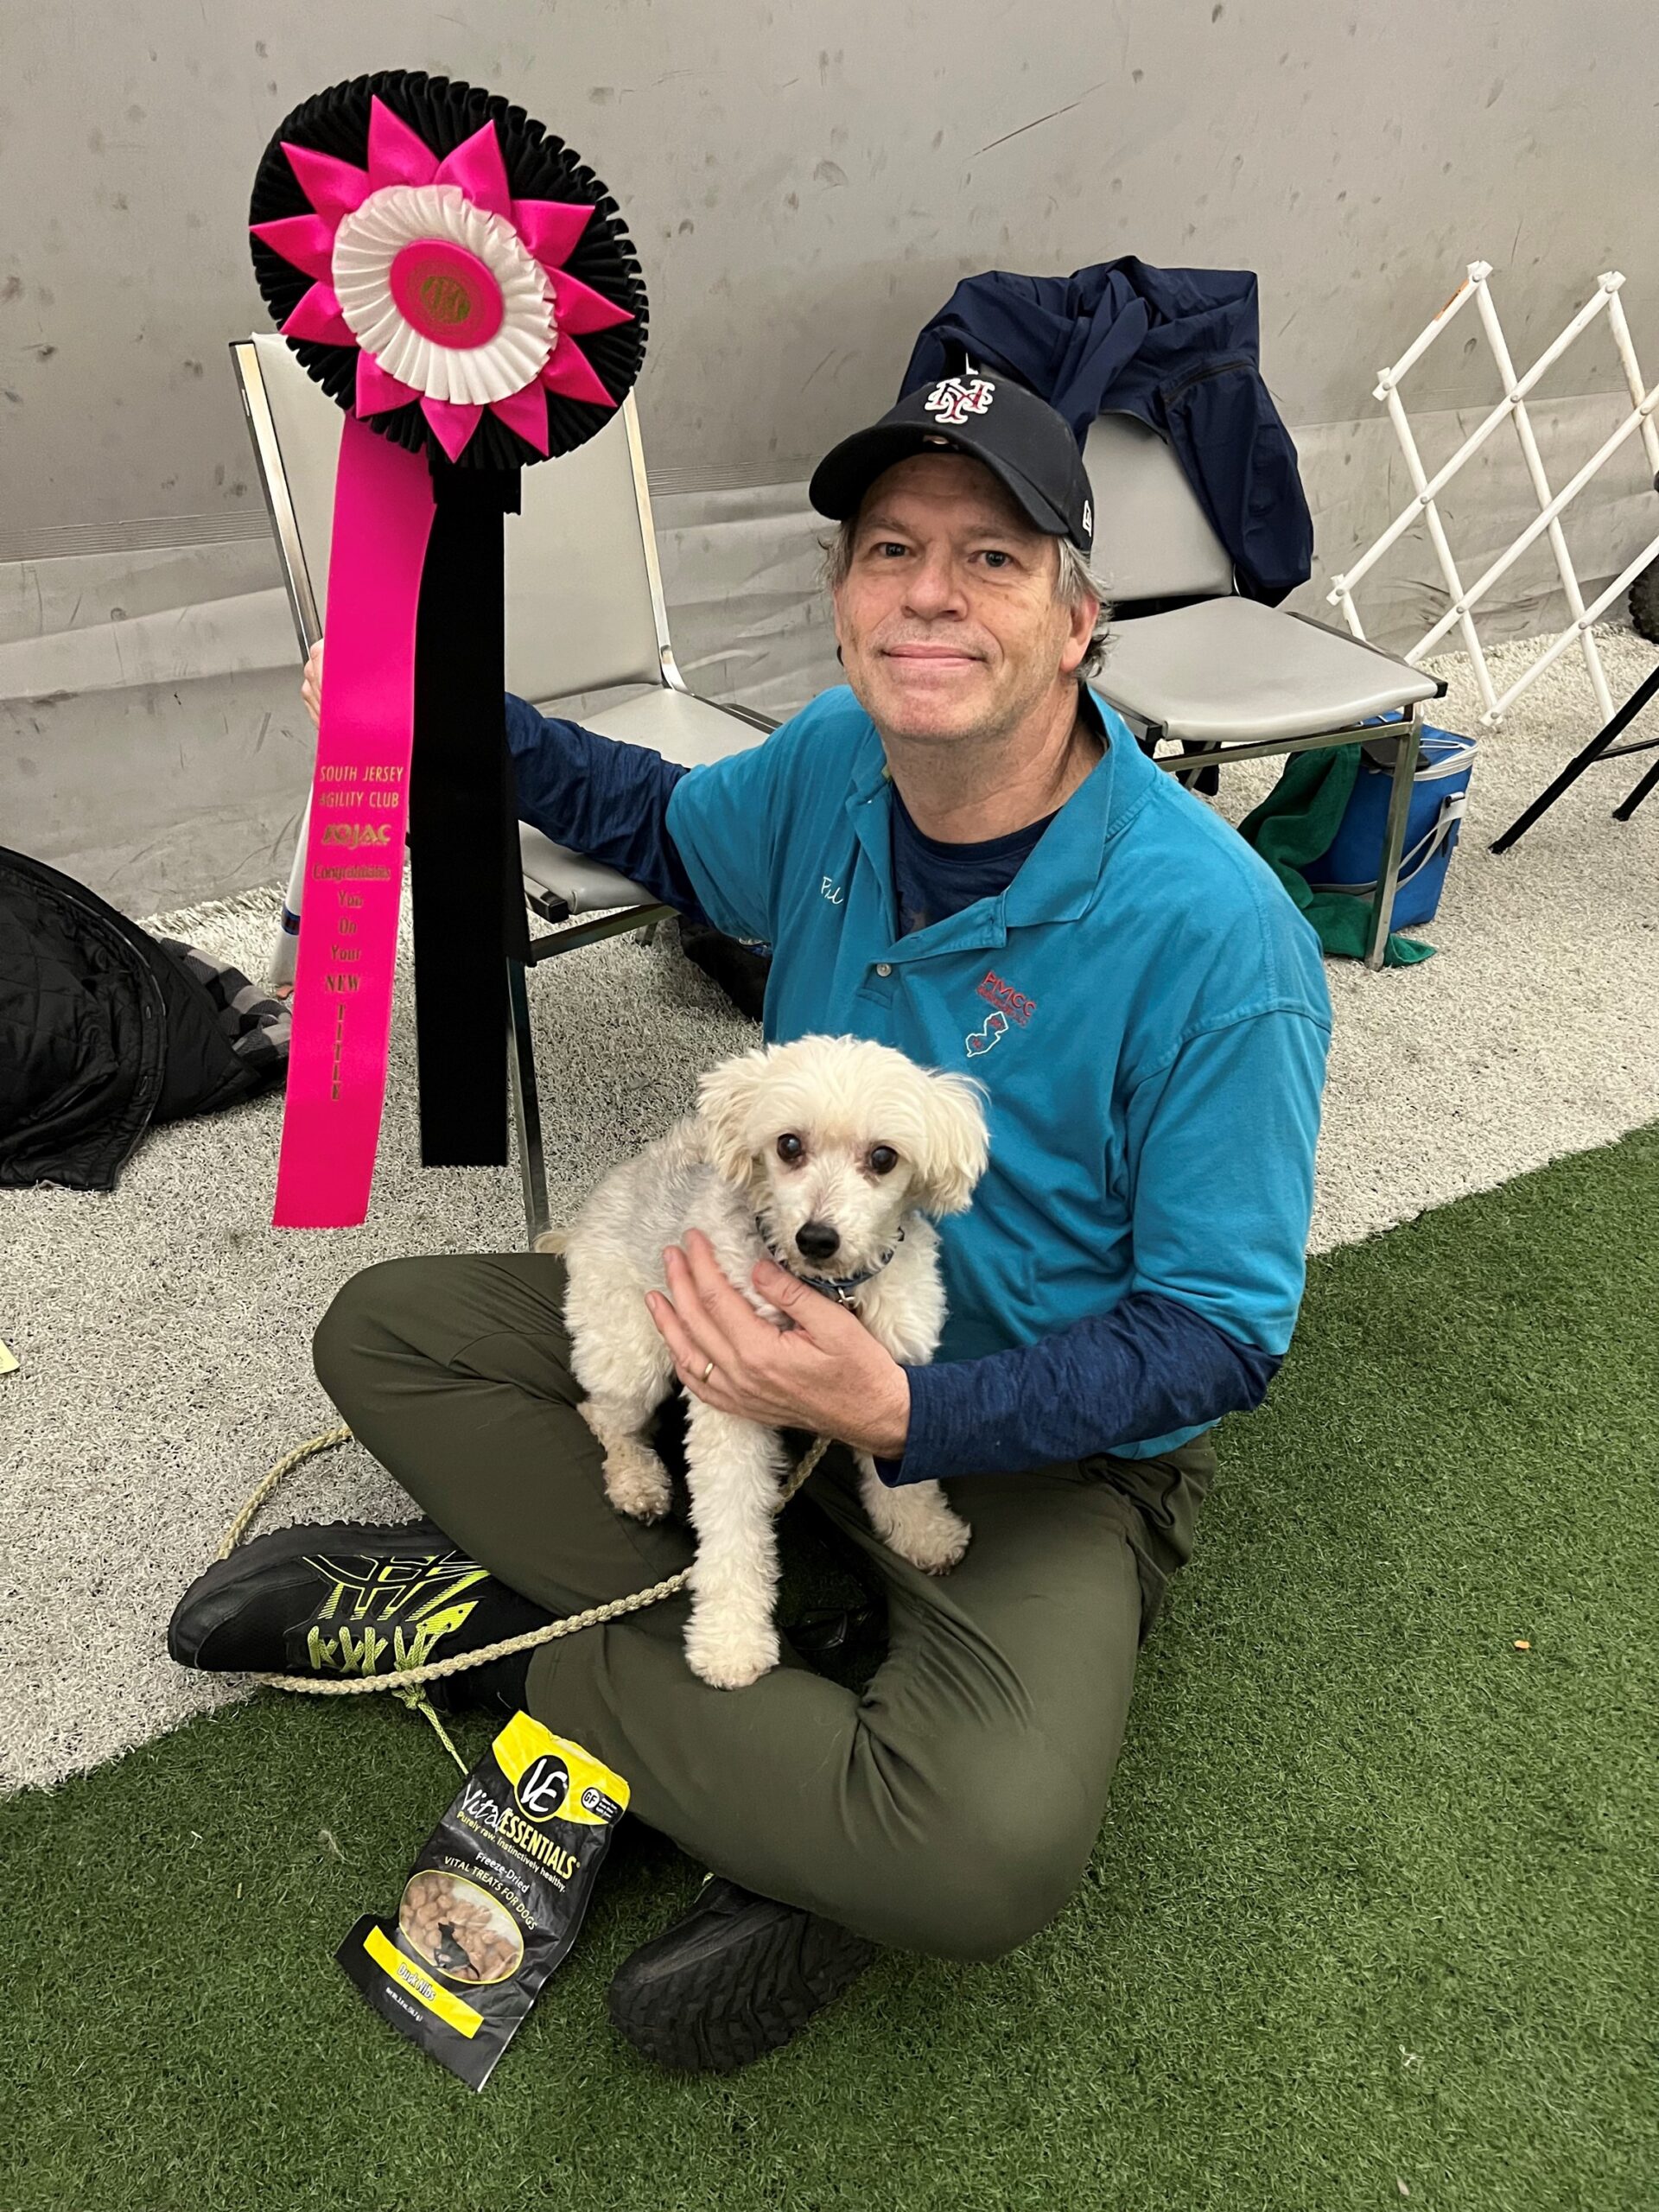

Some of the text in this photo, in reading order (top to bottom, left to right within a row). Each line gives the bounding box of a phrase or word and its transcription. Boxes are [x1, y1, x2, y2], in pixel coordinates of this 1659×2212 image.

[320, 766, 404, 782] SOUTH JERSEY
[319, 791, 399, 808] AGILITY CLUB
[332, 944, 360, 961] Your
[326, 973, 359, 993] NEW
[583, 1791, 598, 1804] GF
[461, 1783, 577, 1879] Vital ESSENTIALS
[457, 1810, 566, 1893] Purely raw. Instinctively healthy.
[475, 1852, 531, 1893] Freeze-Dried
[444, 1856, 537, 1930] VITAL TREATS FOR DOGS
[398, 1962, 436, 2001] Duck Nibs
